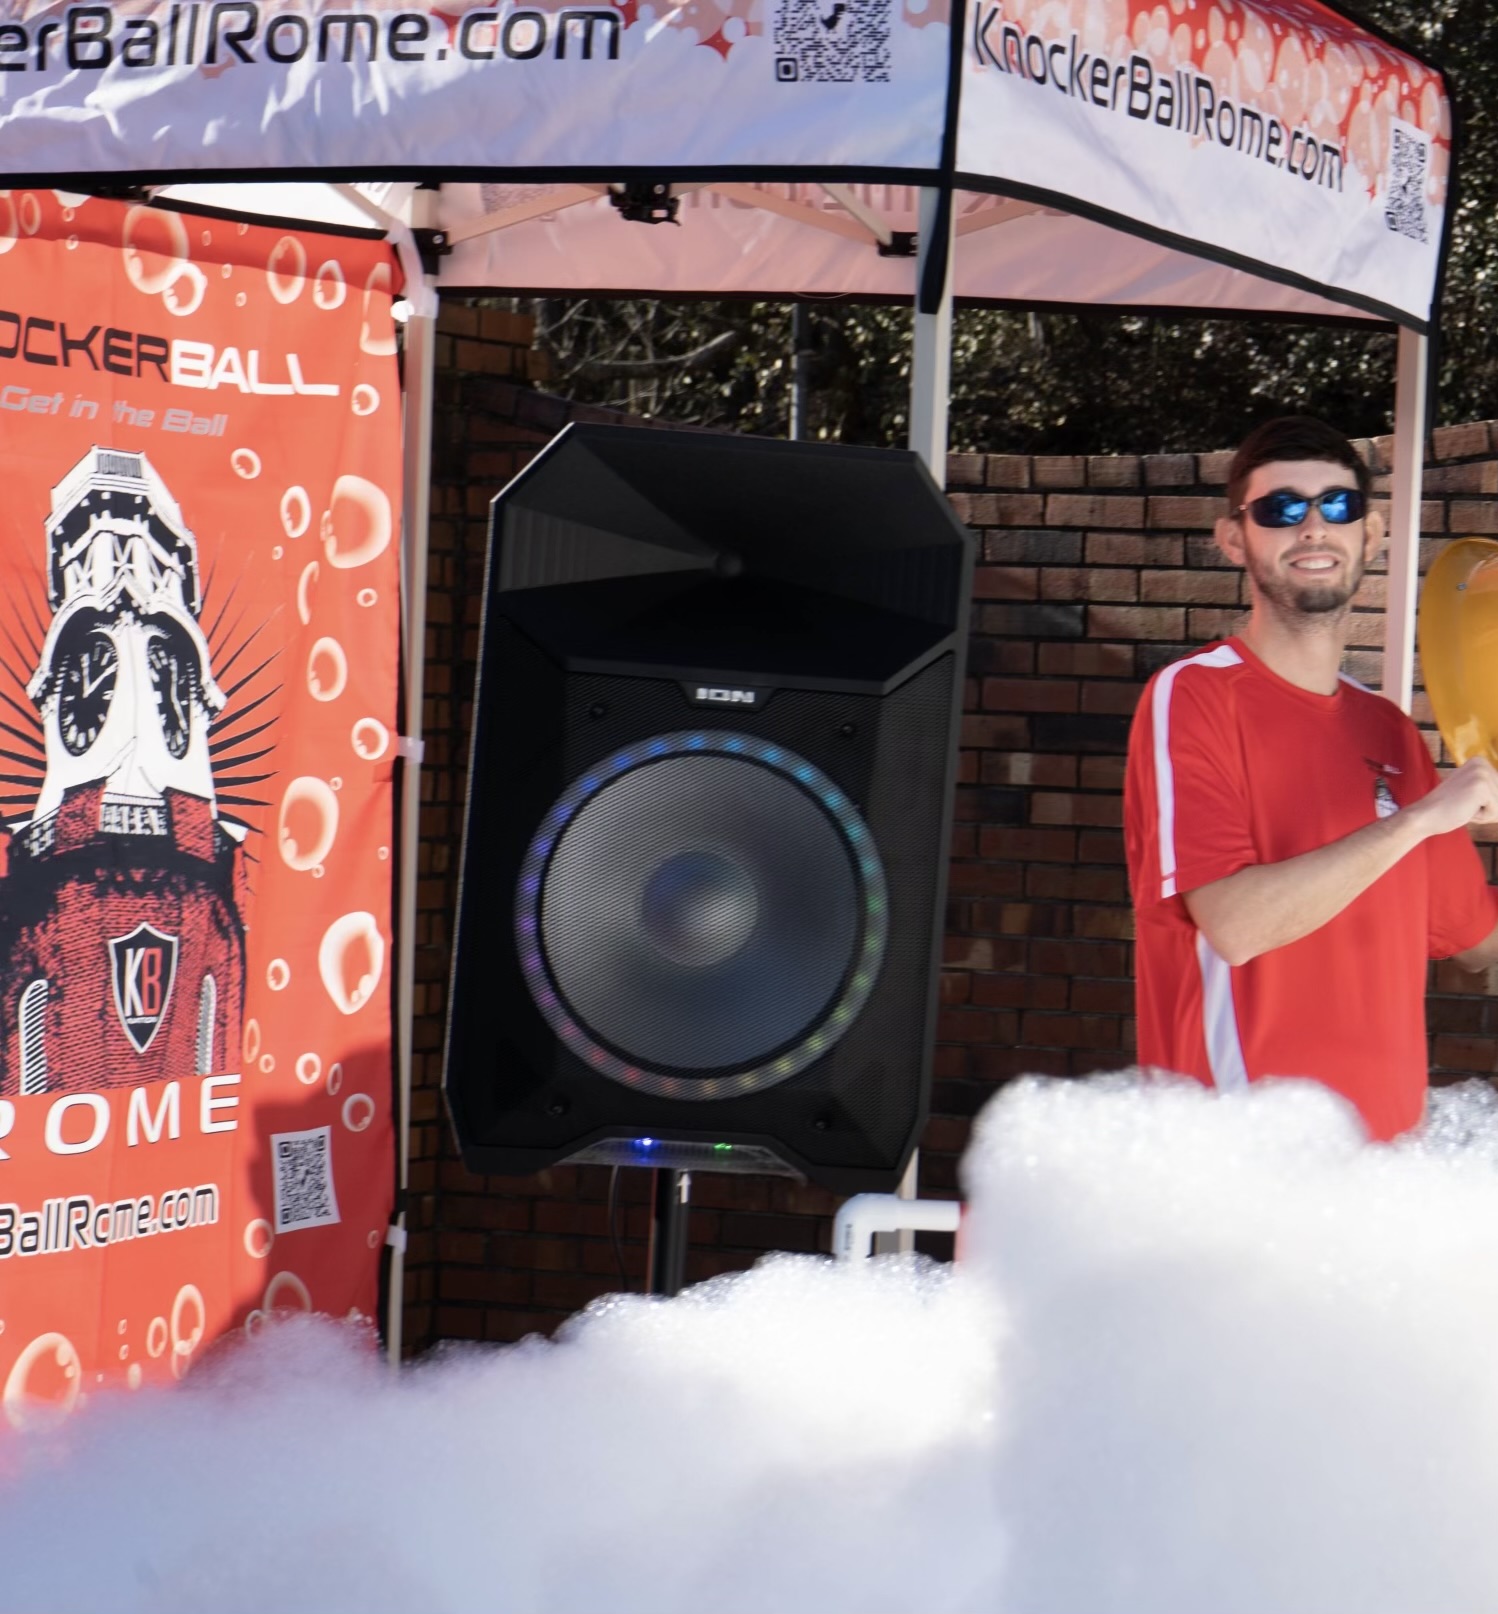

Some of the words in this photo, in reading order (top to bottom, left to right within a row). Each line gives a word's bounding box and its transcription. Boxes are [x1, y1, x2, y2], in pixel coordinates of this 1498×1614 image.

[972, 6, 1343, 192] KnockerBallRome.com
[0, 385, 64, 415] Get
[69, 394, 98, 419] in
[113, 400, 155, 428] the
[161, 408, 228, 437] Ball
[696, 688, 755, 703] ION
[124, 947, 162, 1017] KB
